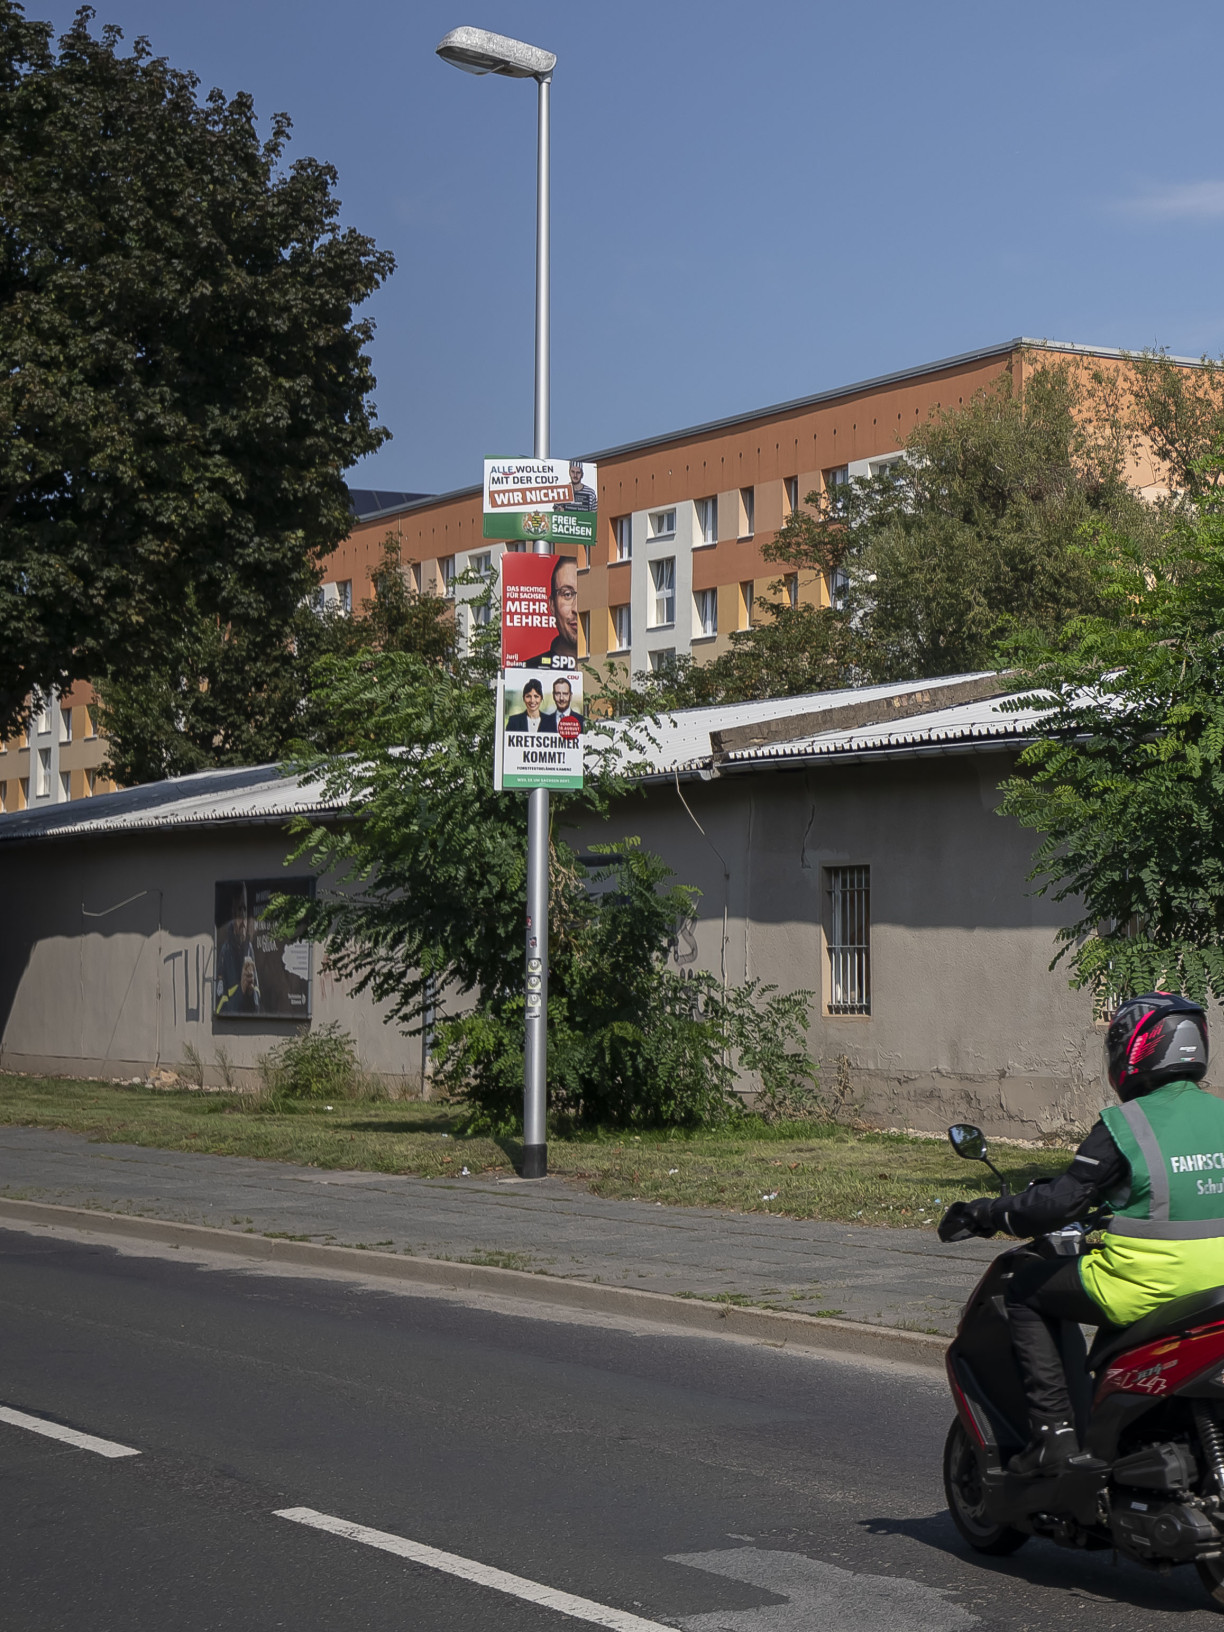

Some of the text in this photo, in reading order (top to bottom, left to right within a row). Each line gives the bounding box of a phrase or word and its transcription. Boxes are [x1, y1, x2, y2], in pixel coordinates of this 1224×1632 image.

[490, 465, 554, 474] ALLE WOLLEN
[491, 476, 559, 485] MIT DER CDU?
[494, 491, 523, 505] WIR
[525, 488, 569, 503] NICHT!
[552, 515, 577, 526] FREIE
[552, 525, 592, 536] SACHSEN
[506, 600, 548, 613] MEHR
[506, 614, 557, 628] LEHRER
[552, 655, 576, 669] SPD
[508, 735, 580, 749] KRETSCHMER
[523, 751, 566, 764] KOMMT!
